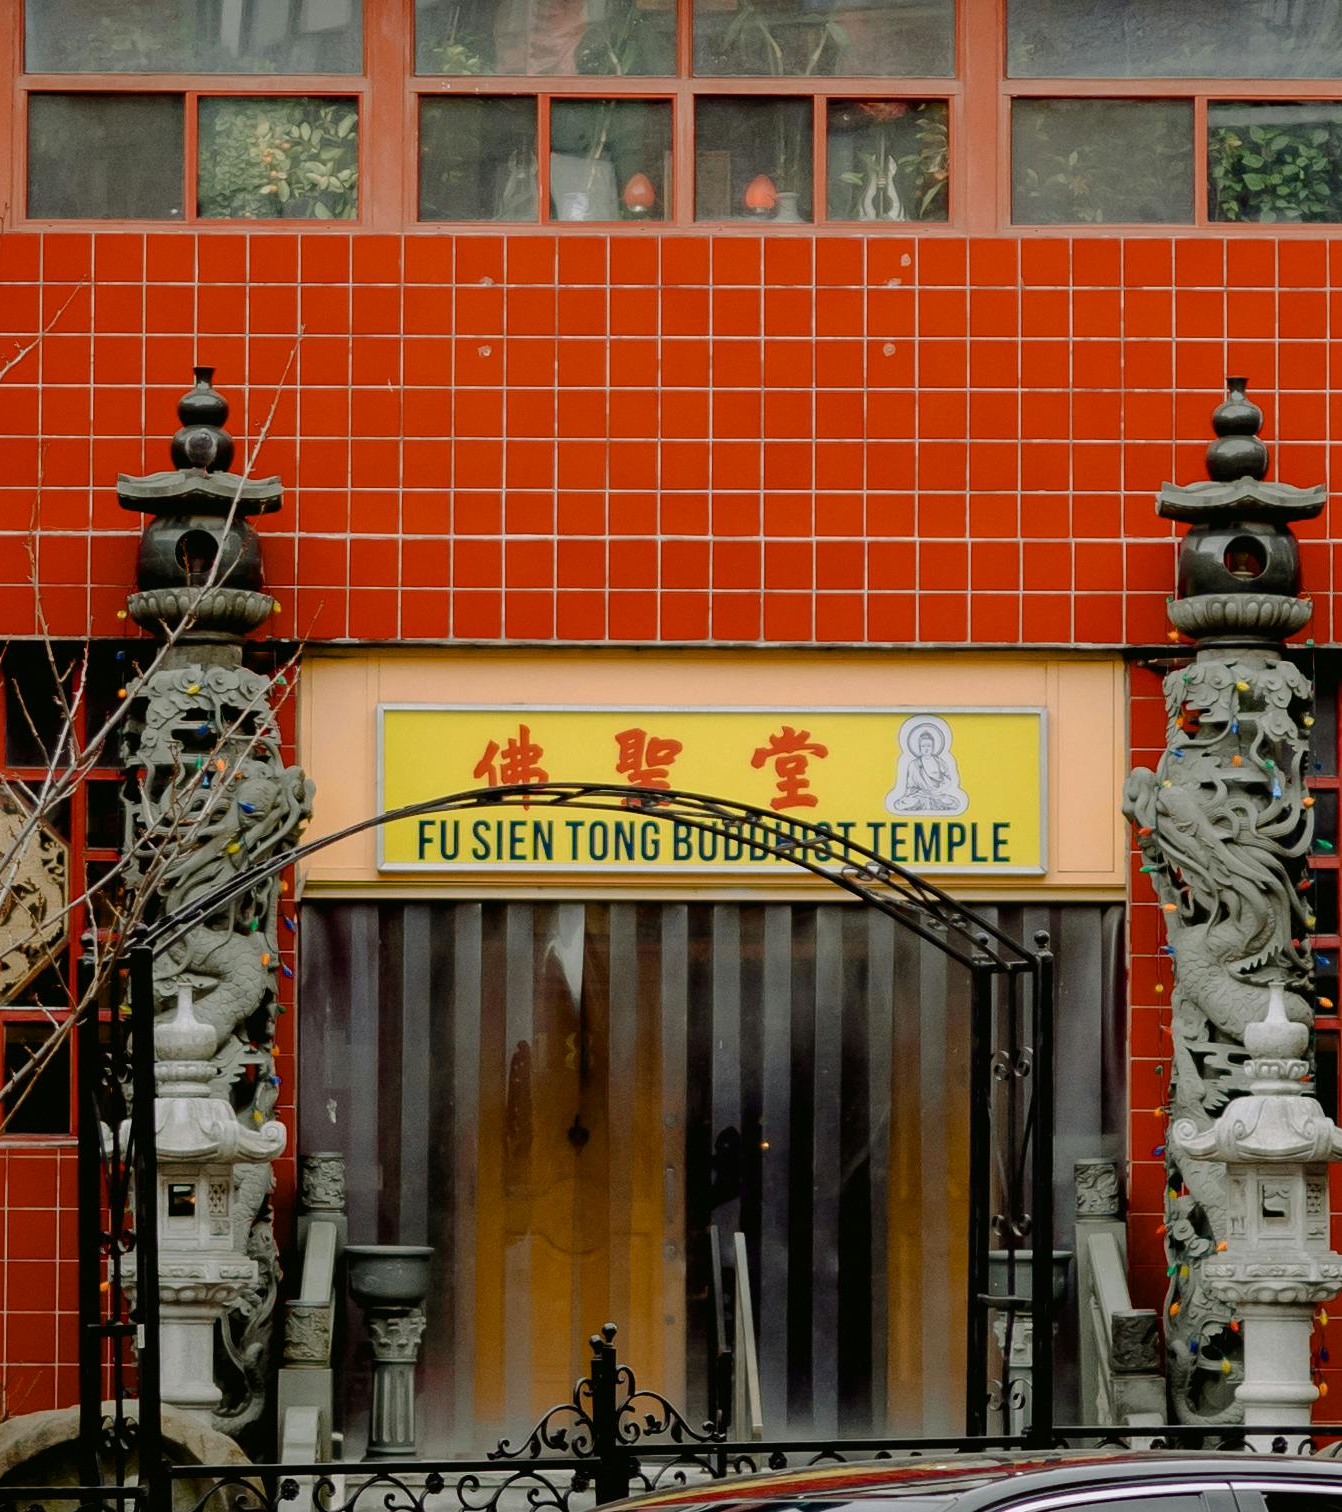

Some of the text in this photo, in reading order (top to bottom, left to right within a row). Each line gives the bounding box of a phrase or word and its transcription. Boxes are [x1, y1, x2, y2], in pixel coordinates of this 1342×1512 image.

[473, 724, 829, 811] 佛聖堂
[418, 820, 1011, 863] FU SIEN TONG BUDDHIST TEMPLE
